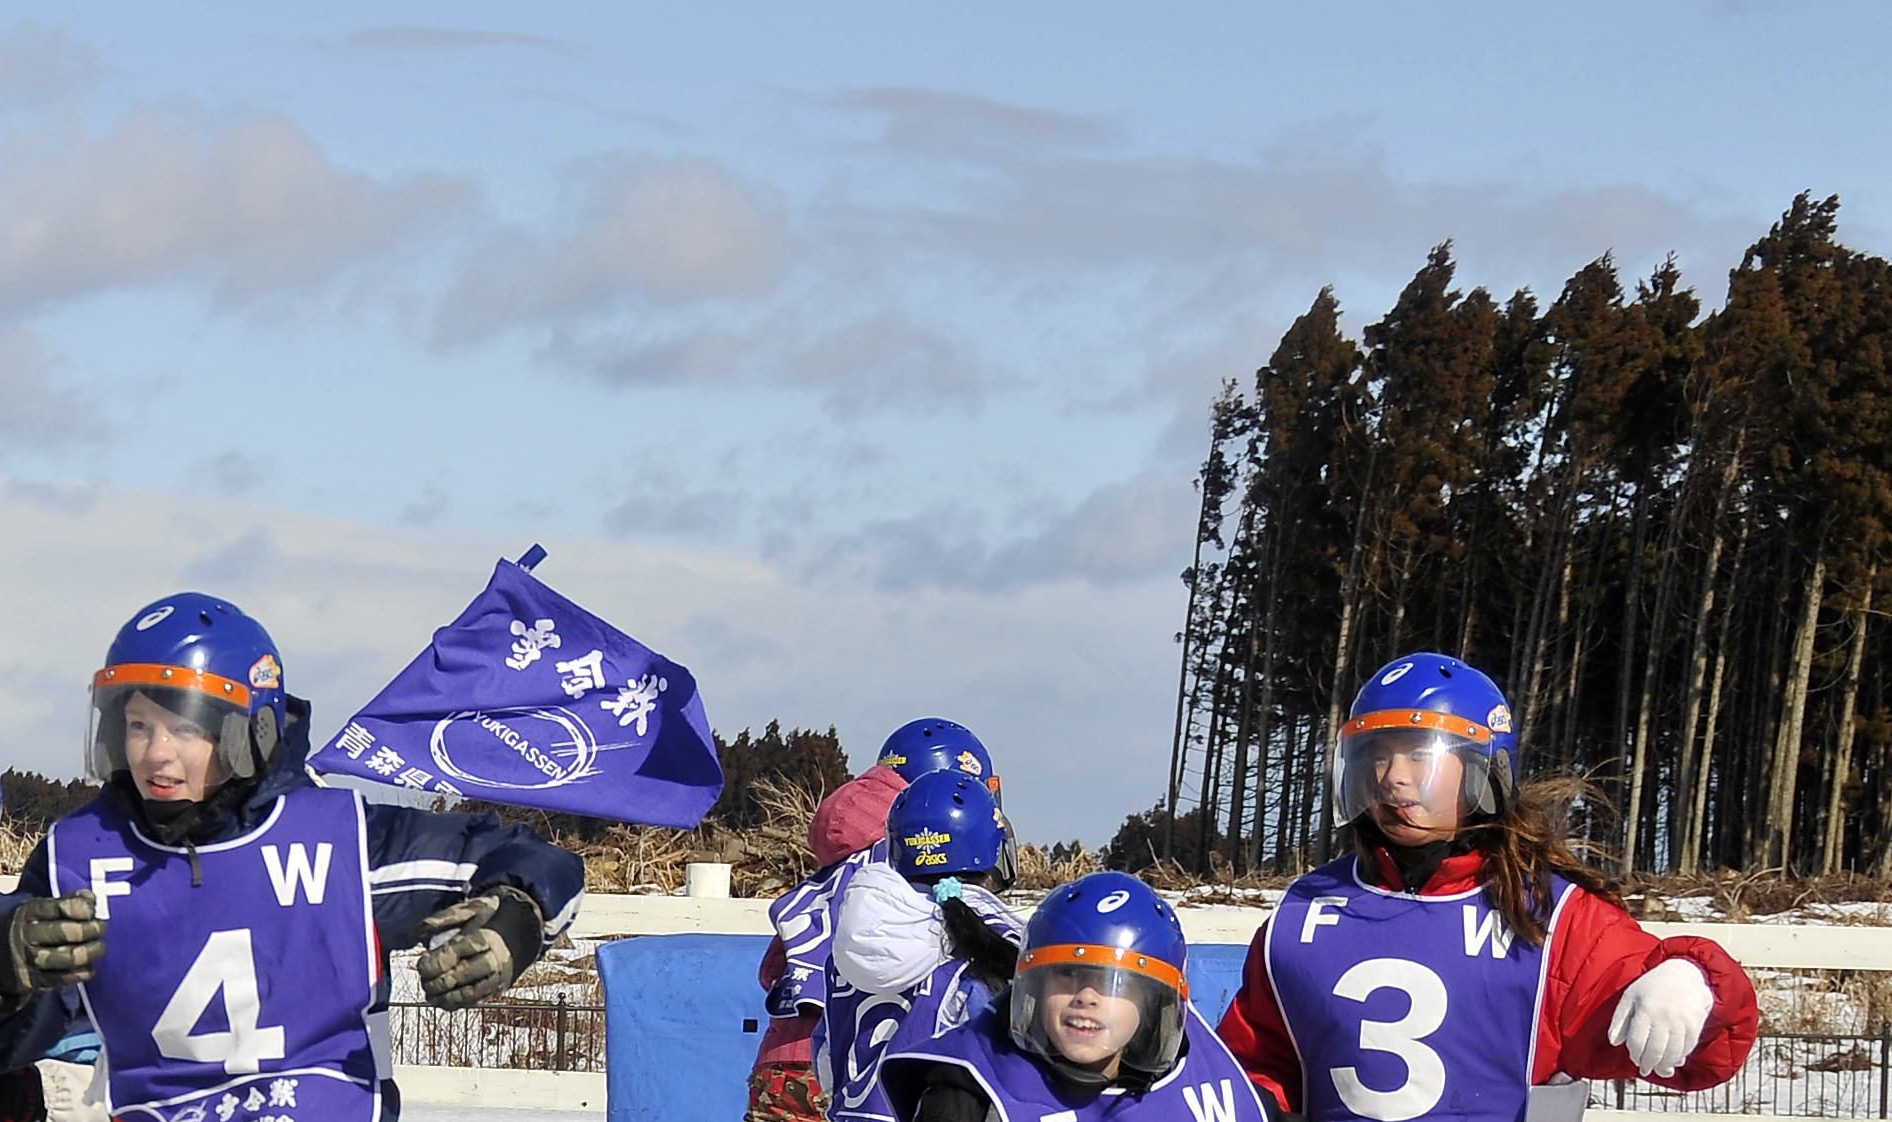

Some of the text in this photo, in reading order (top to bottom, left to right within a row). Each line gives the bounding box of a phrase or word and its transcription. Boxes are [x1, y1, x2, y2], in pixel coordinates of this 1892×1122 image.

[473, 710, 567, 780] YUKIGASSEN
[90, 842, 334, 920] F W
[1300, 896, 1516, 959] F W
[151, 928, 286, 1075] 4
[1329, 957, 1449, 1122] 3
